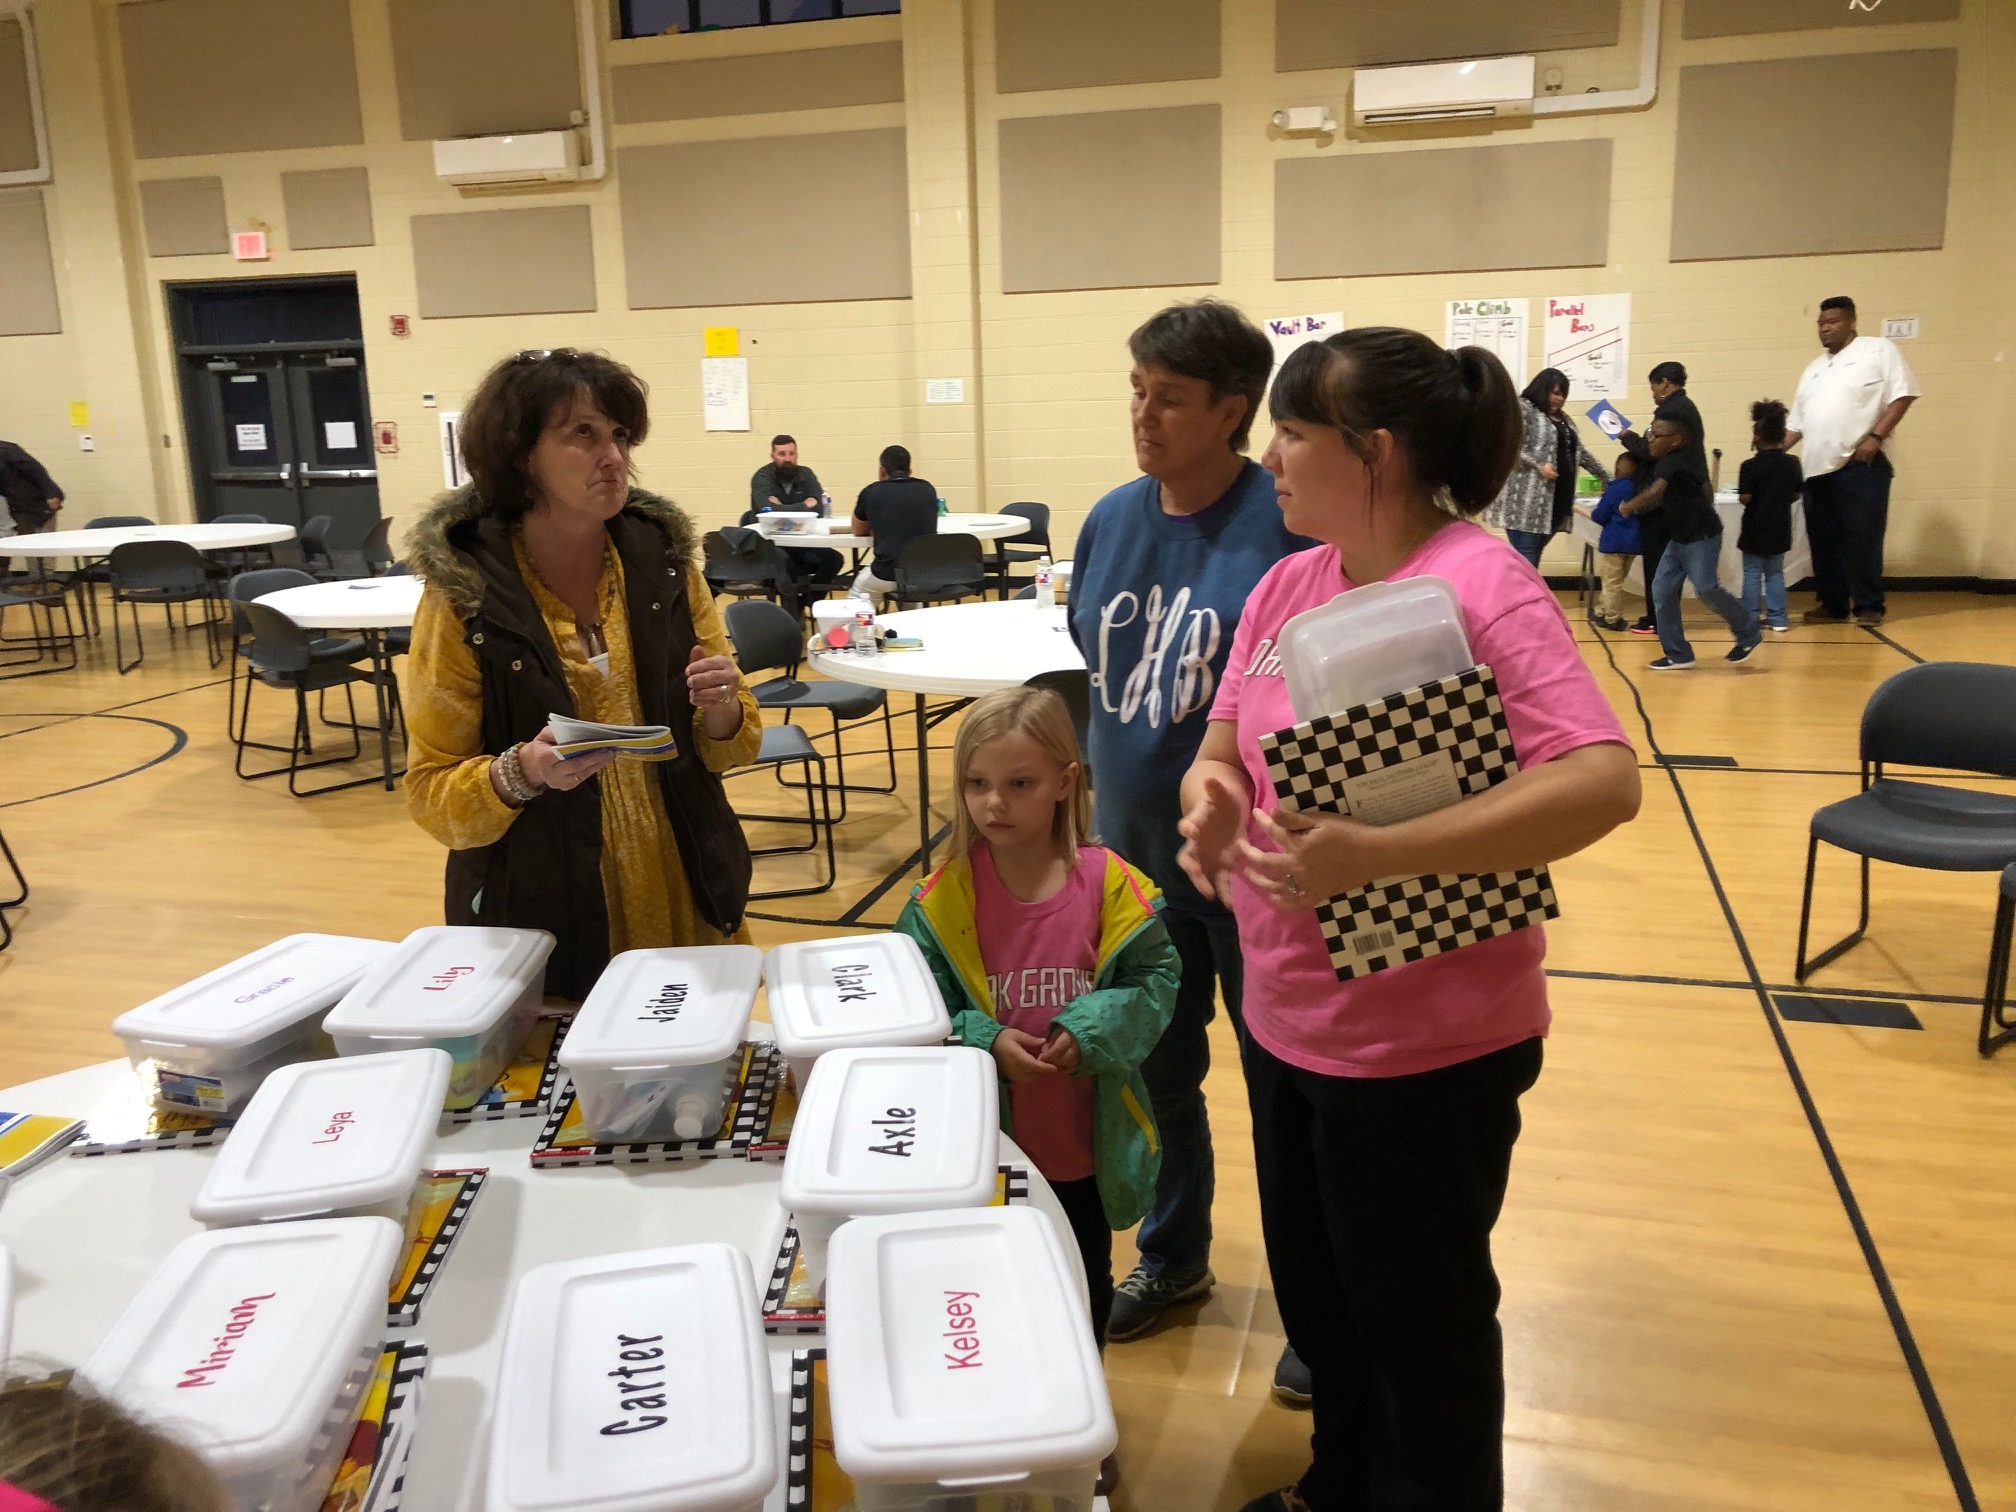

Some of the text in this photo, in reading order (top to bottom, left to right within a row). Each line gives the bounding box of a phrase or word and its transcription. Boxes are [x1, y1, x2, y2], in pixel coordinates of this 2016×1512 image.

[1269, 319, 1301, 336] Vault
[1452, 301, 1512, 316] Pole Climb
[1549, 299, 1585, 317] Parallel
[1570, 317, 1595, 333] Bars
[1242, 638, 1283, 677] OA
[234, 975, 296, 1004] Gracie
[422, 965, 476, 992] Lily
[832, 963, 878, 1004] Clark
[986, 971, 1015, 1011] AK
[637, 982, 688, 1024] Jaiden
[311, 1110, 355, 1147] Leya
[868, 1105, 917, 1158] Axle
[176, 1291, 276, 1389] Miriam
[943, 1290, 984, 1371] Kelsey
[599, 1333, 668, 1436] Carter
